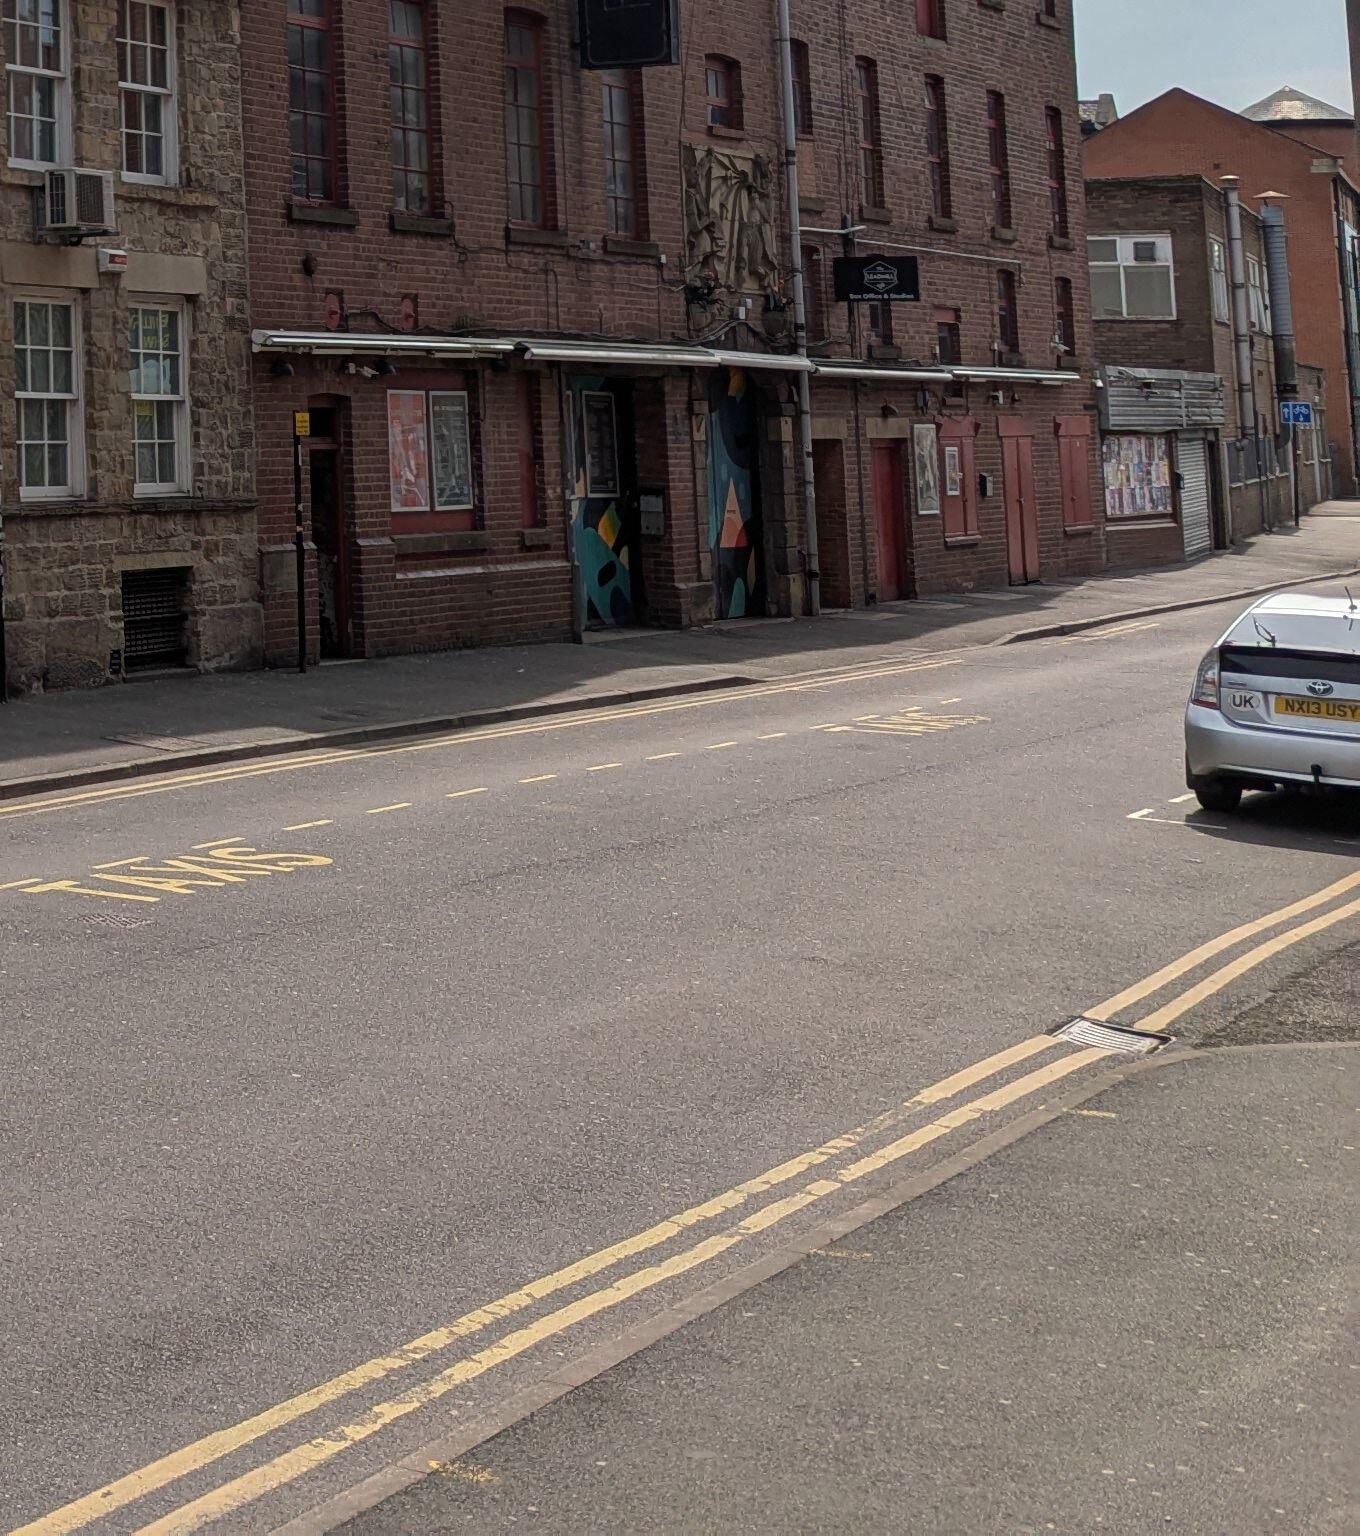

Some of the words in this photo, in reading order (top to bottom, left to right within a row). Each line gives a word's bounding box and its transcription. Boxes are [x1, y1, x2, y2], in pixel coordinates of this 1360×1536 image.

[1232, 694, 1255, 709] UK
[1284, 698, 1322, 714] NX13
[1325, 701, 1360, 718] USY
[18, 847, 334, 902] TAXIS
